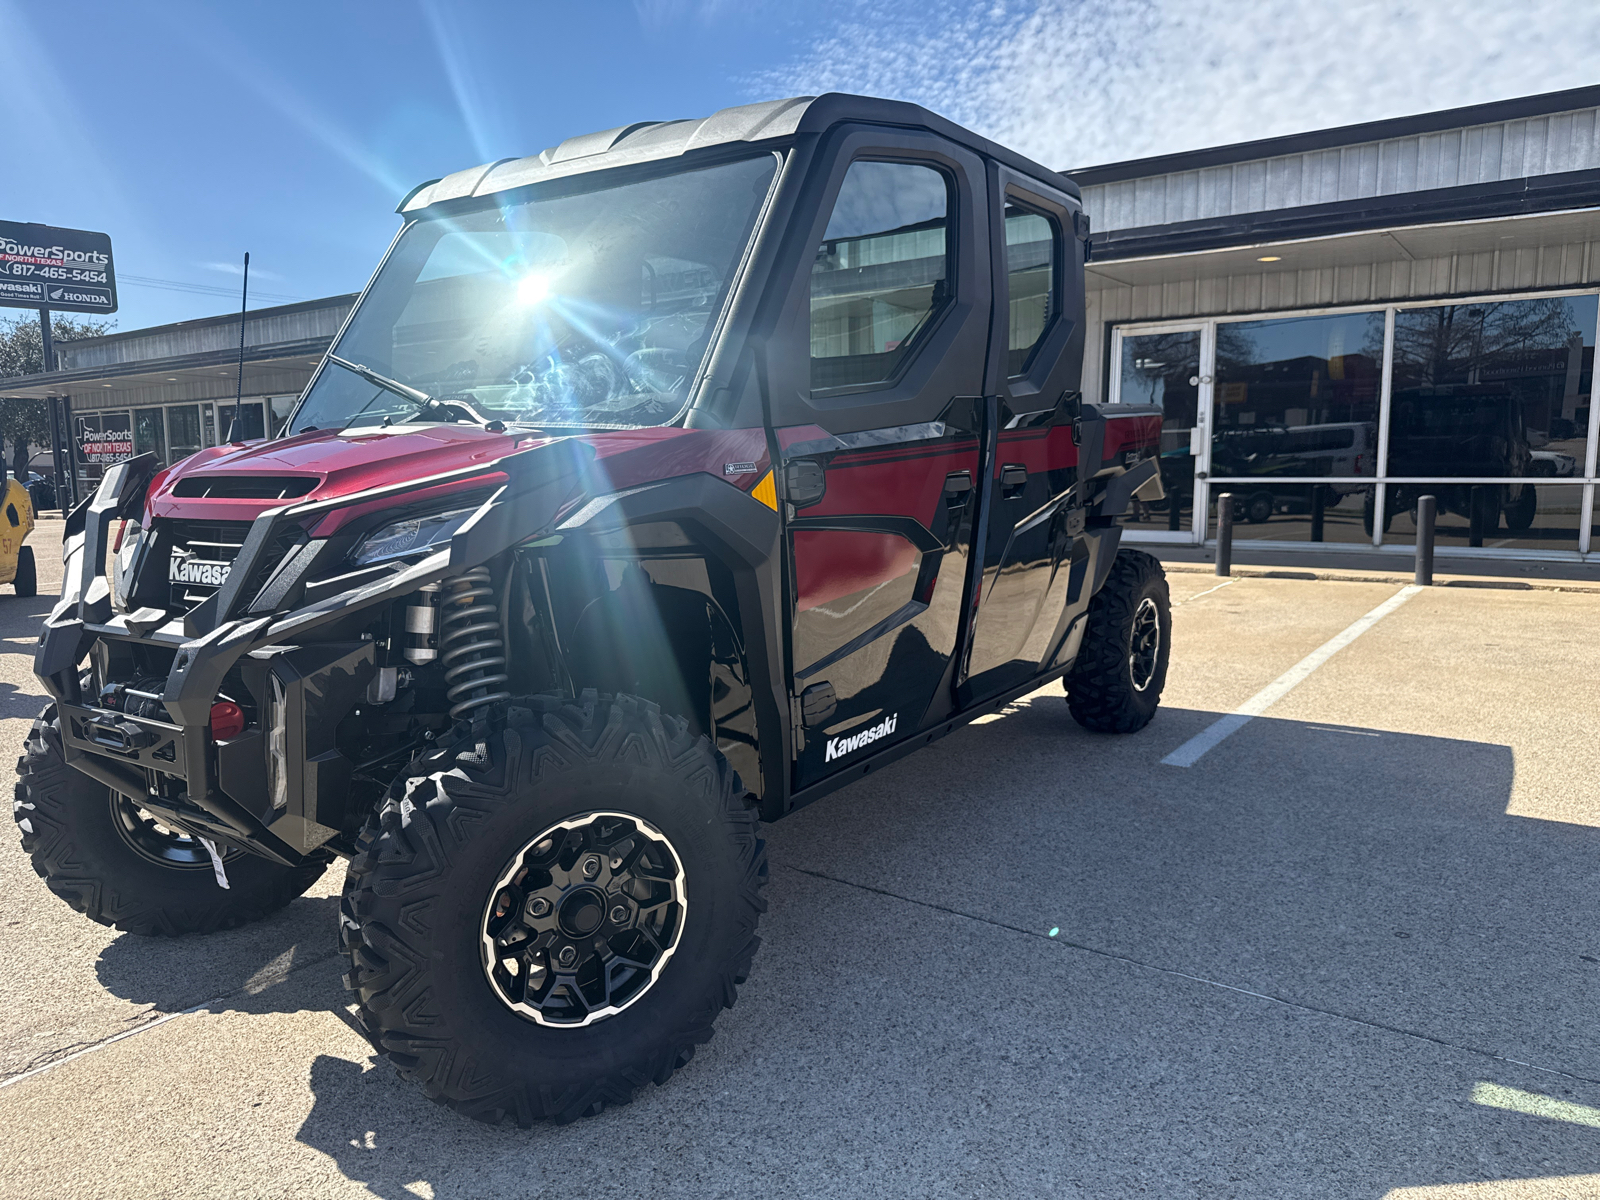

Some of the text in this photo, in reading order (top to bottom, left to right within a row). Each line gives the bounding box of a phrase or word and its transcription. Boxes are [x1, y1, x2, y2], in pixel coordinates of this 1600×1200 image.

[5, 254, 36, 264] NORTH
[36, 258, 62, 267] TEXAS
[13, 263, 107, 284] 817-465-5454
[63, 292, 109, 304] HONDA
[84, 443, 92, 453] OF
[112, 442, 131, 452] TEXAS
[2, 538, 12, 554] 57
[169, 557, 232, 585] Kawasa
[825, 712, 898, 763] Kawasaki
